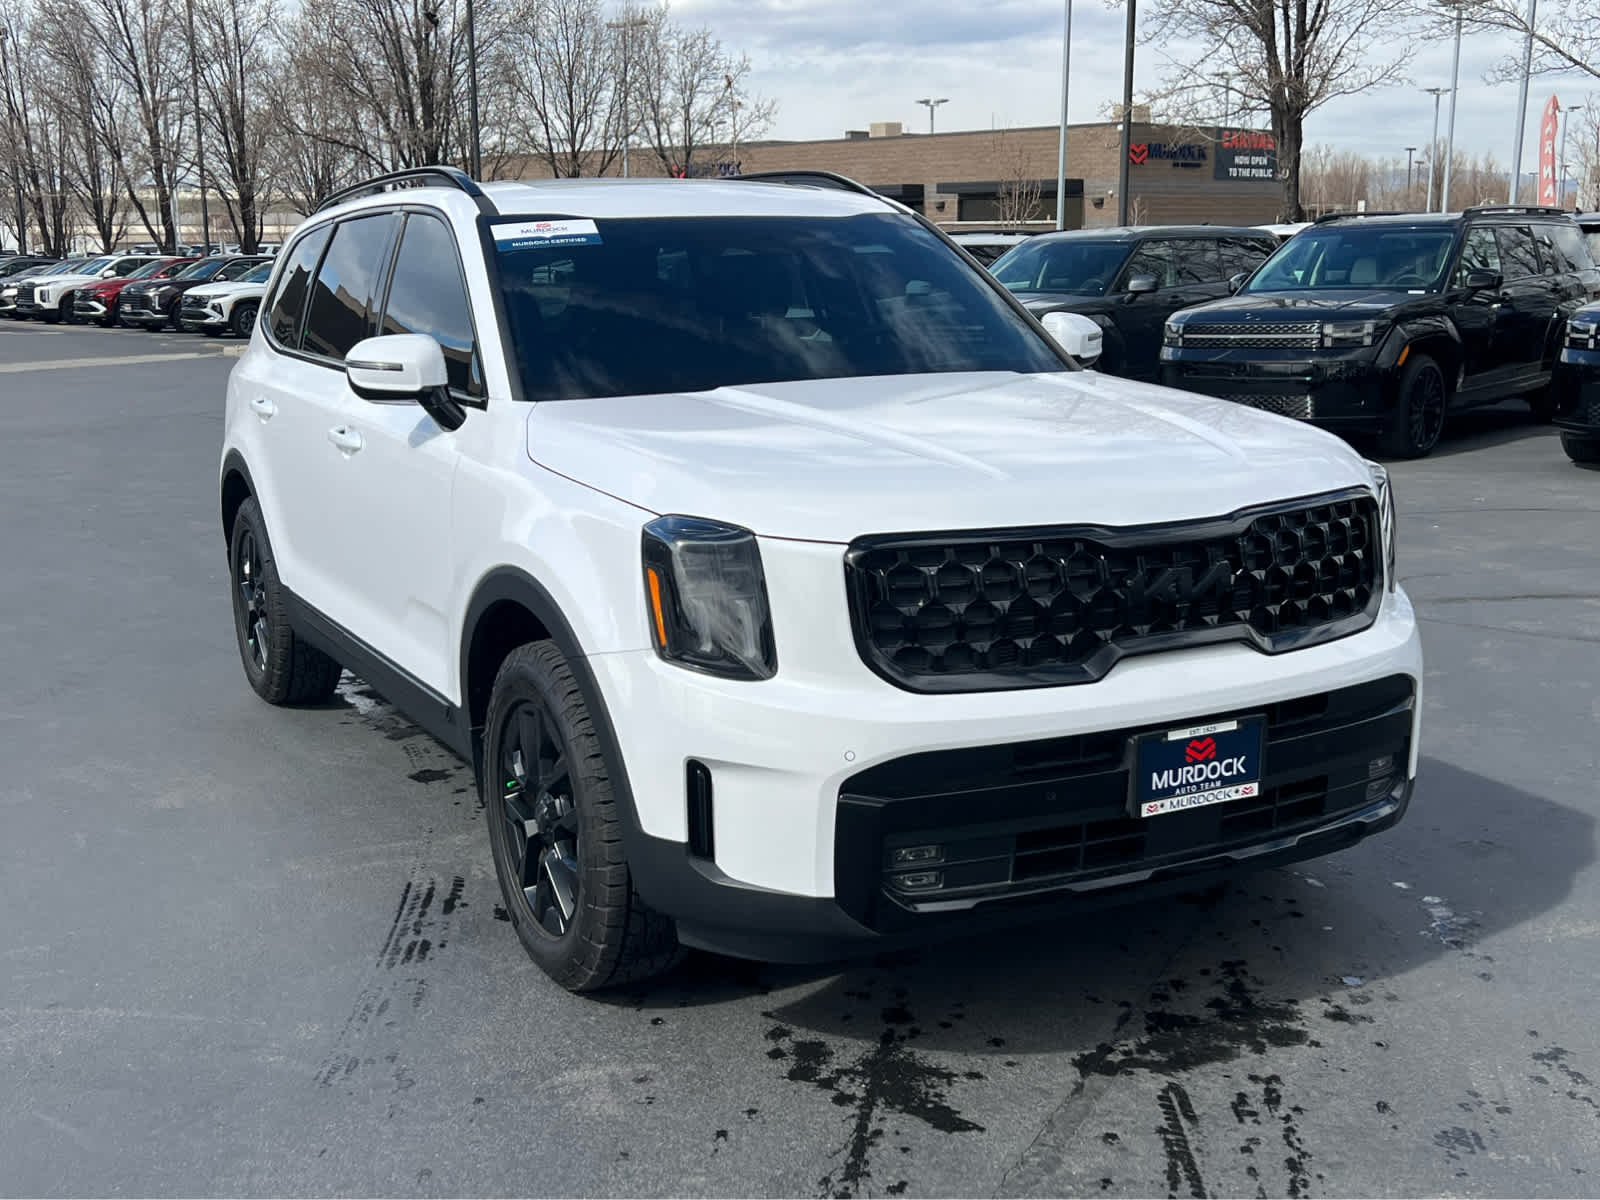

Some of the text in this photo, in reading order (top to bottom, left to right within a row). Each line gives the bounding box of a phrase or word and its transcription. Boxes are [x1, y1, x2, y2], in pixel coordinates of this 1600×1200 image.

[1234, 156, 1268, 165] NOW OPEN
[1228, 168, 1273, 178] TO THE PUBLIC
[512, 239, 550, 247] MURDOCK
[1151, 755, 1247, 791] MURDOCK
[1174, 780, 1222, 796] AUTO TEAM
[1169, 789, 1232, 809] MURDOCK
